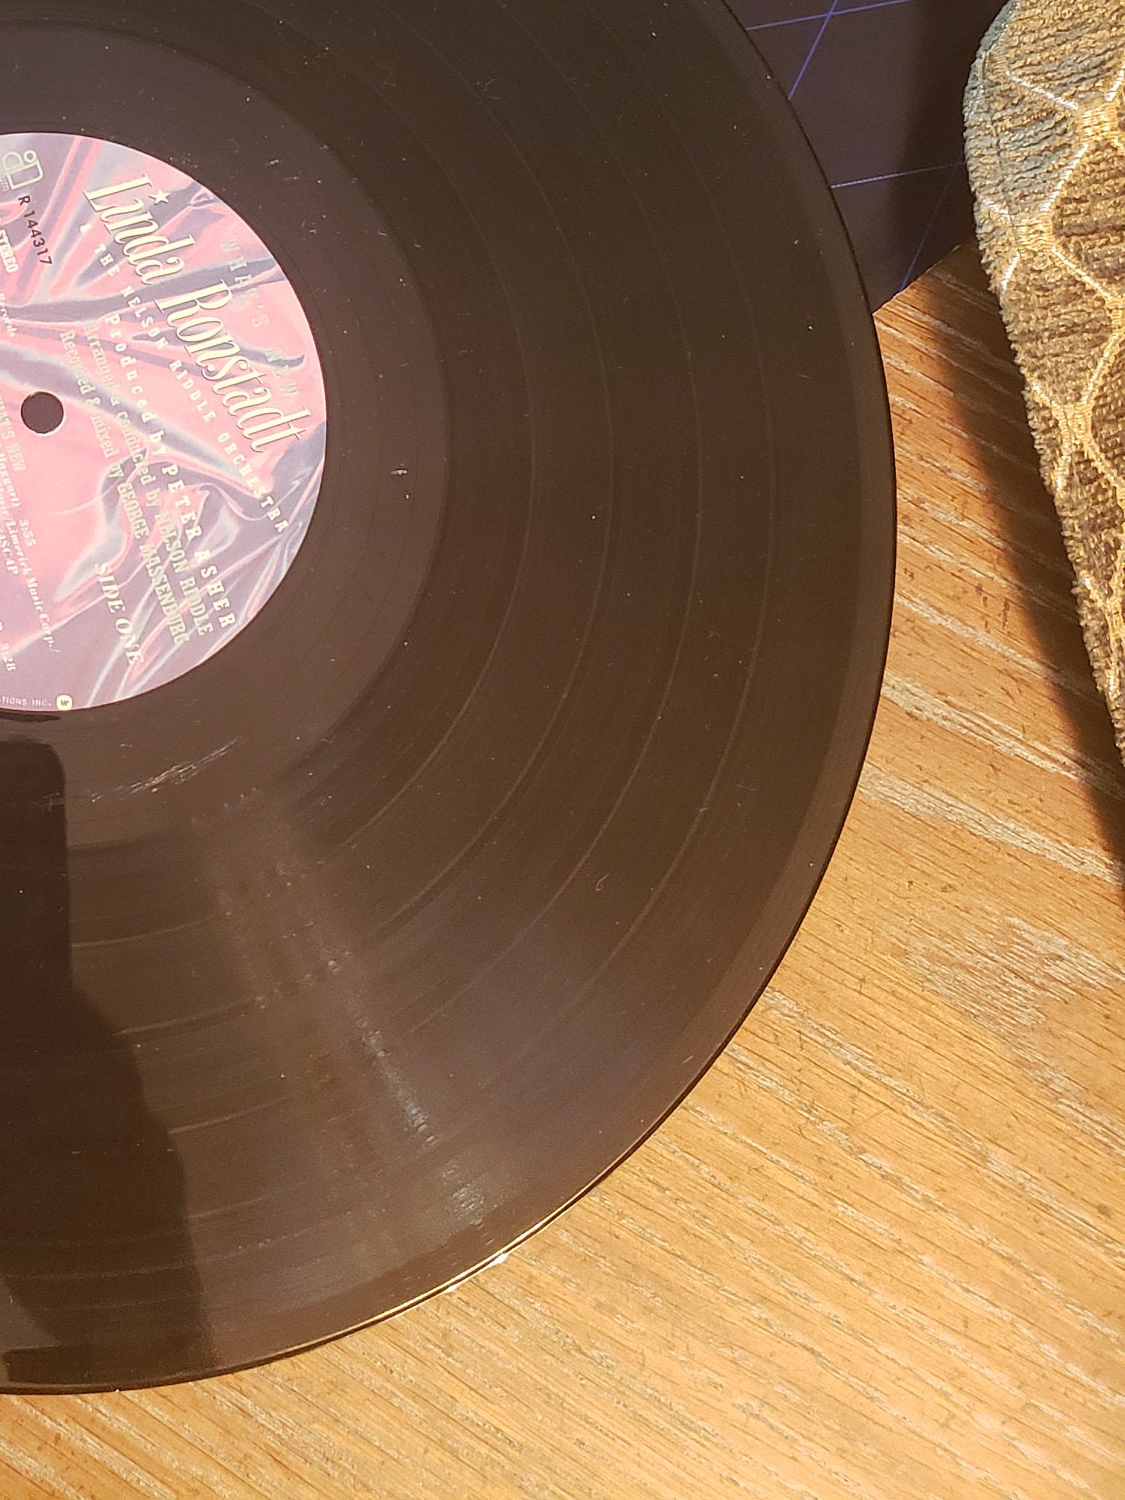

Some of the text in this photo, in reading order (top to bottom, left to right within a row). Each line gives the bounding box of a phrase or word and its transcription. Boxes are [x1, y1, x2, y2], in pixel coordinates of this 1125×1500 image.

[16, 194, 53, 268] R 144317
[81, 173, 312, 452] Linda Ronstadt
[92, 243, 120, 277] THE
[119, 284, 168, 350] NELSON
[168, 358, 216, 422] RIDDLE
[216, 431, 290, 533] ORCHESTRA
[264, 346, 299, 399] NEW
[5, 442, 27, 473] NEW
[58, 328, 190, 646] Recorded & mixed by GEORGE MASSENBURG
[81, 320, 214, 636] Arranged & conducted by NELSON RIDDLE
[103, 313, 237, 629] Produced by PETER ASHER
[17, 516, 37, 548] 3:55
[24, 575, 46, 614] Music
[93, 559, 145, 667] SIDE ONE
